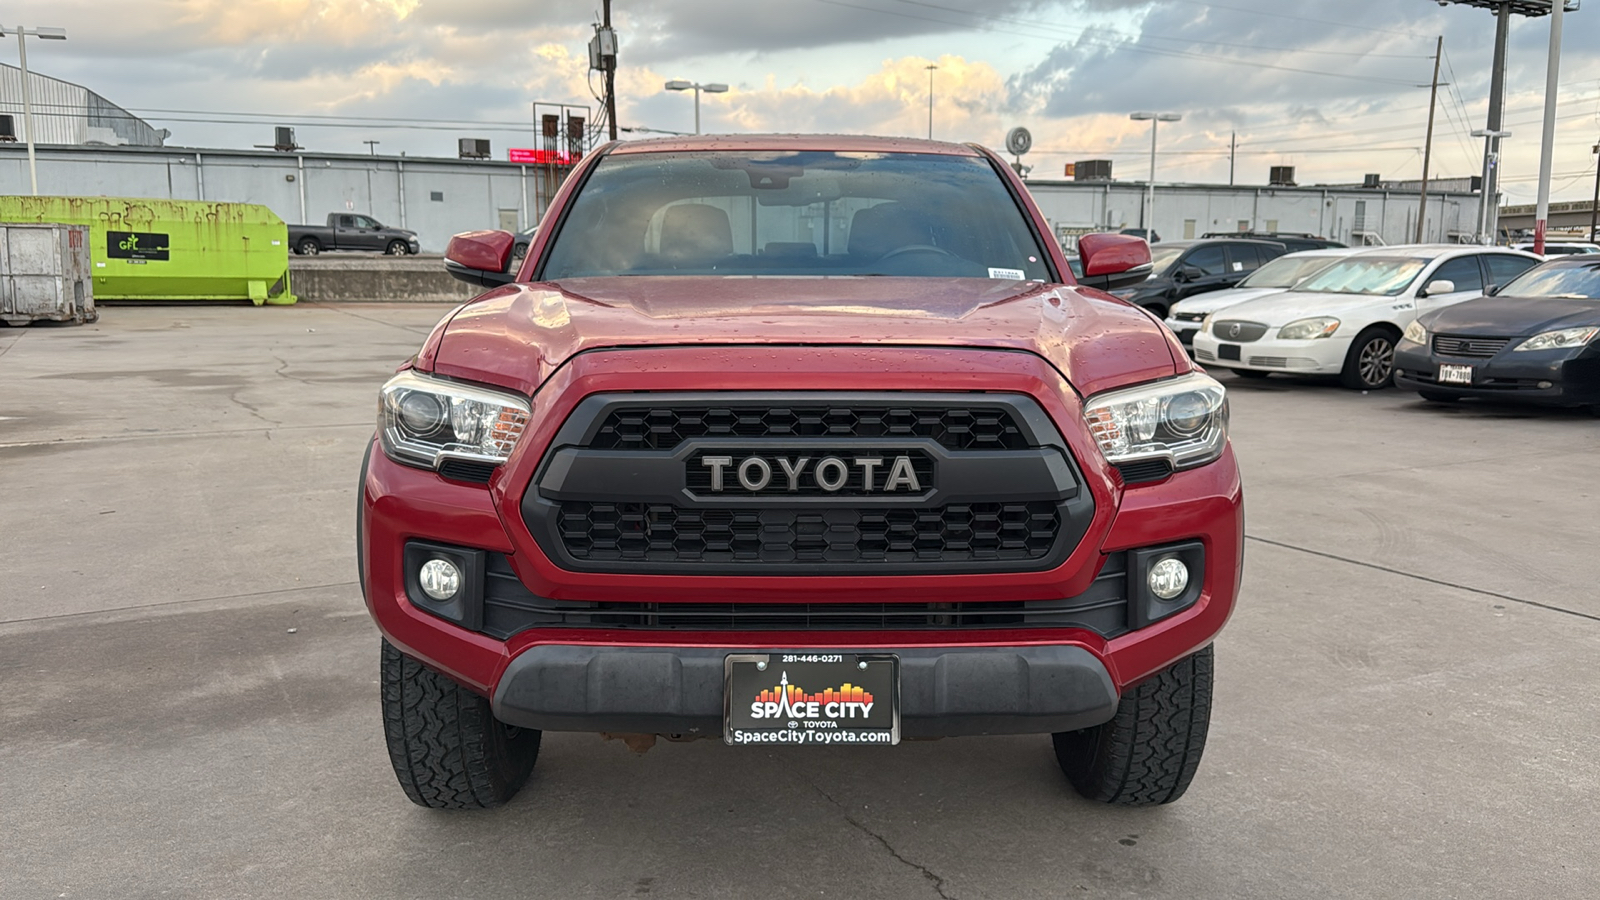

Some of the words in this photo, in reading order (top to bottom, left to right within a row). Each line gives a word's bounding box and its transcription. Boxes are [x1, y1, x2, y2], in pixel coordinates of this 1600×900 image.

[119, 238, 139, 250] GFL
[702, 455, 921, 491] TOYOTA
[782, 654, 843, 663] 281-446-0271
[750, 701, 820, 719] SPACE
[824, 701, 874, 719] CITY
[802, 720, 838, 729] TOYOTA
[734, 729, 891, 744] SpaceCityToyota.com
